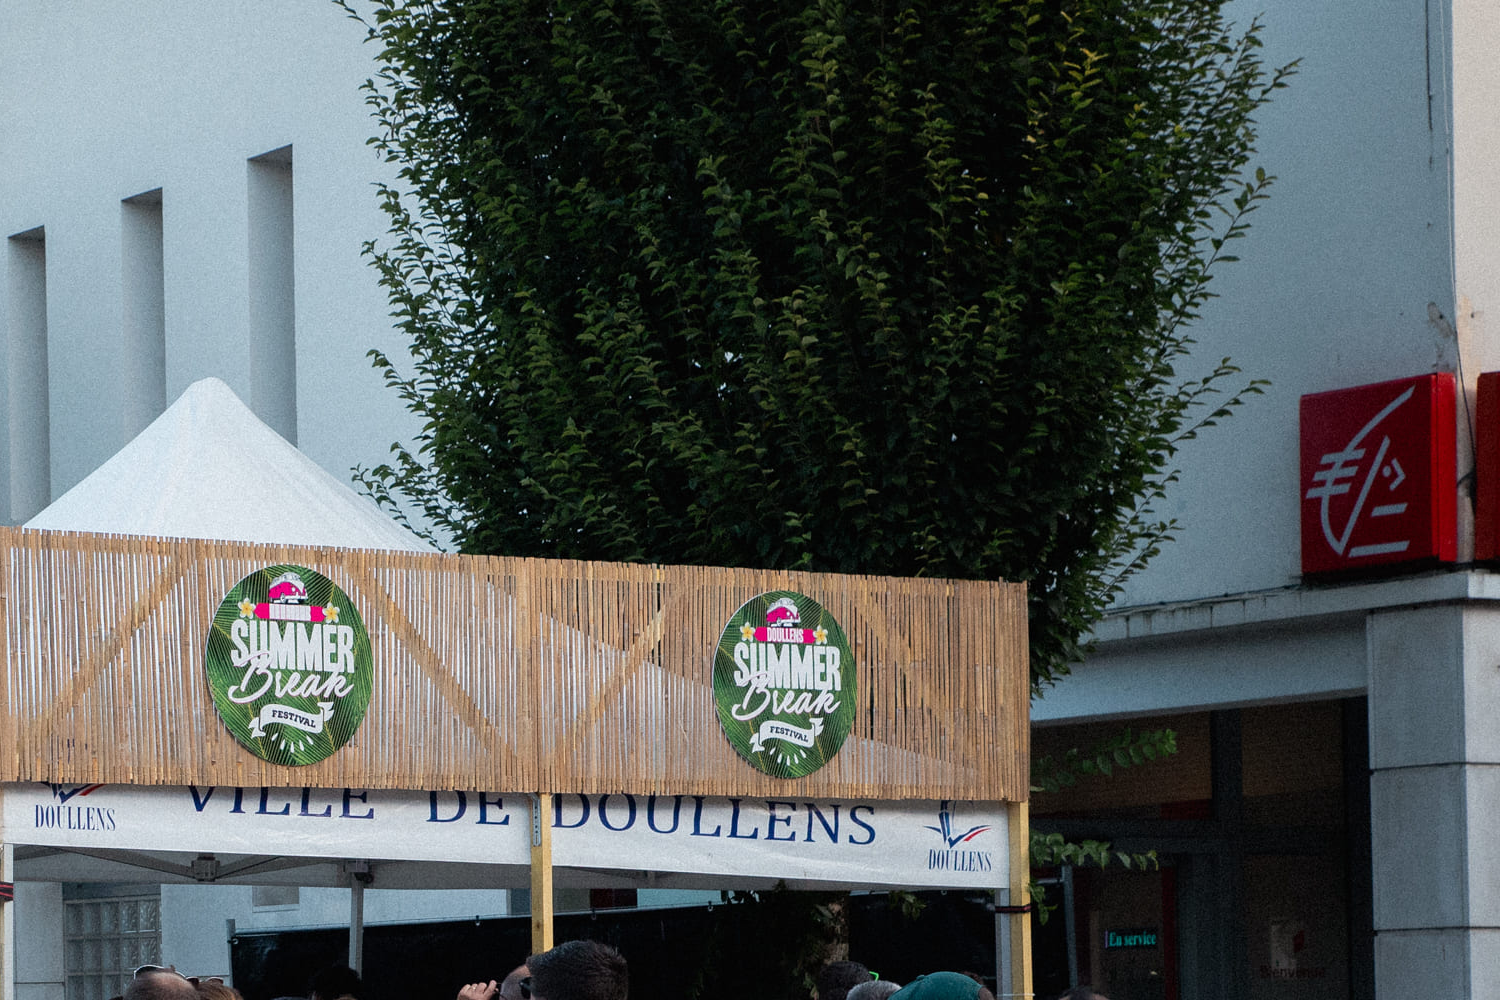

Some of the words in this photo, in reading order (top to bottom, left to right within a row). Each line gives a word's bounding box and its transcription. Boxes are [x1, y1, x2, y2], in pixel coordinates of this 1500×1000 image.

[230, 618, 355, 674] SUMMER
[766, 626, 804, 643] DOULLENS
[228, 651, 355, 704] Break
[733, 642, 842, 691] SUMMER
[731, 671, 842, 721] Break
[272, 709, 316, 728] FESTIVAL
[769, 725, 809, 743] FESTIVAL
[35, 804, 116, 831] DOULLENS
[188, 785, 375, 819] VILLE
[426, 789, 510, 825] DE
[550, 793, 877, 845] DOULLENS
[928, 848, 992, 873] DOULLENS
[1109, 931, 1122, 947] En
[1124, 930, 1157, 946] service
